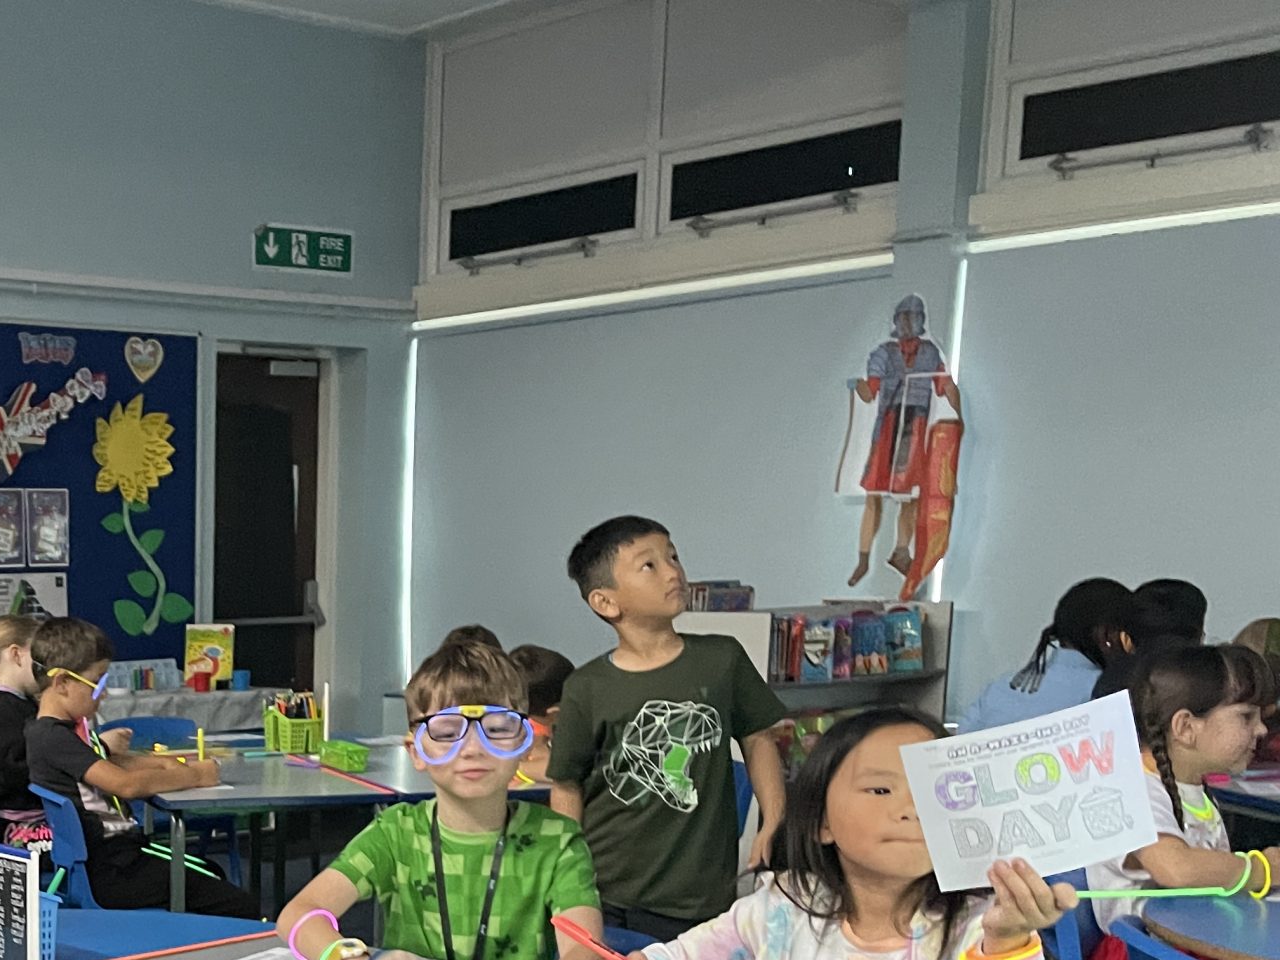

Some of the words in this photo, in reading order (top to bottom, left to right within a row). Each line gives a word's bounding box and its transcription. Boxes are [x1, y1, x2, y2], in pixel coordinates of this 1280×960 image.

[319, 254, 344, 268] EXIT
[320, 236, 345, 252] FIRE
[934, 730, 1115, 812] GLOW
[948, 792, 1080, 859] DAY
